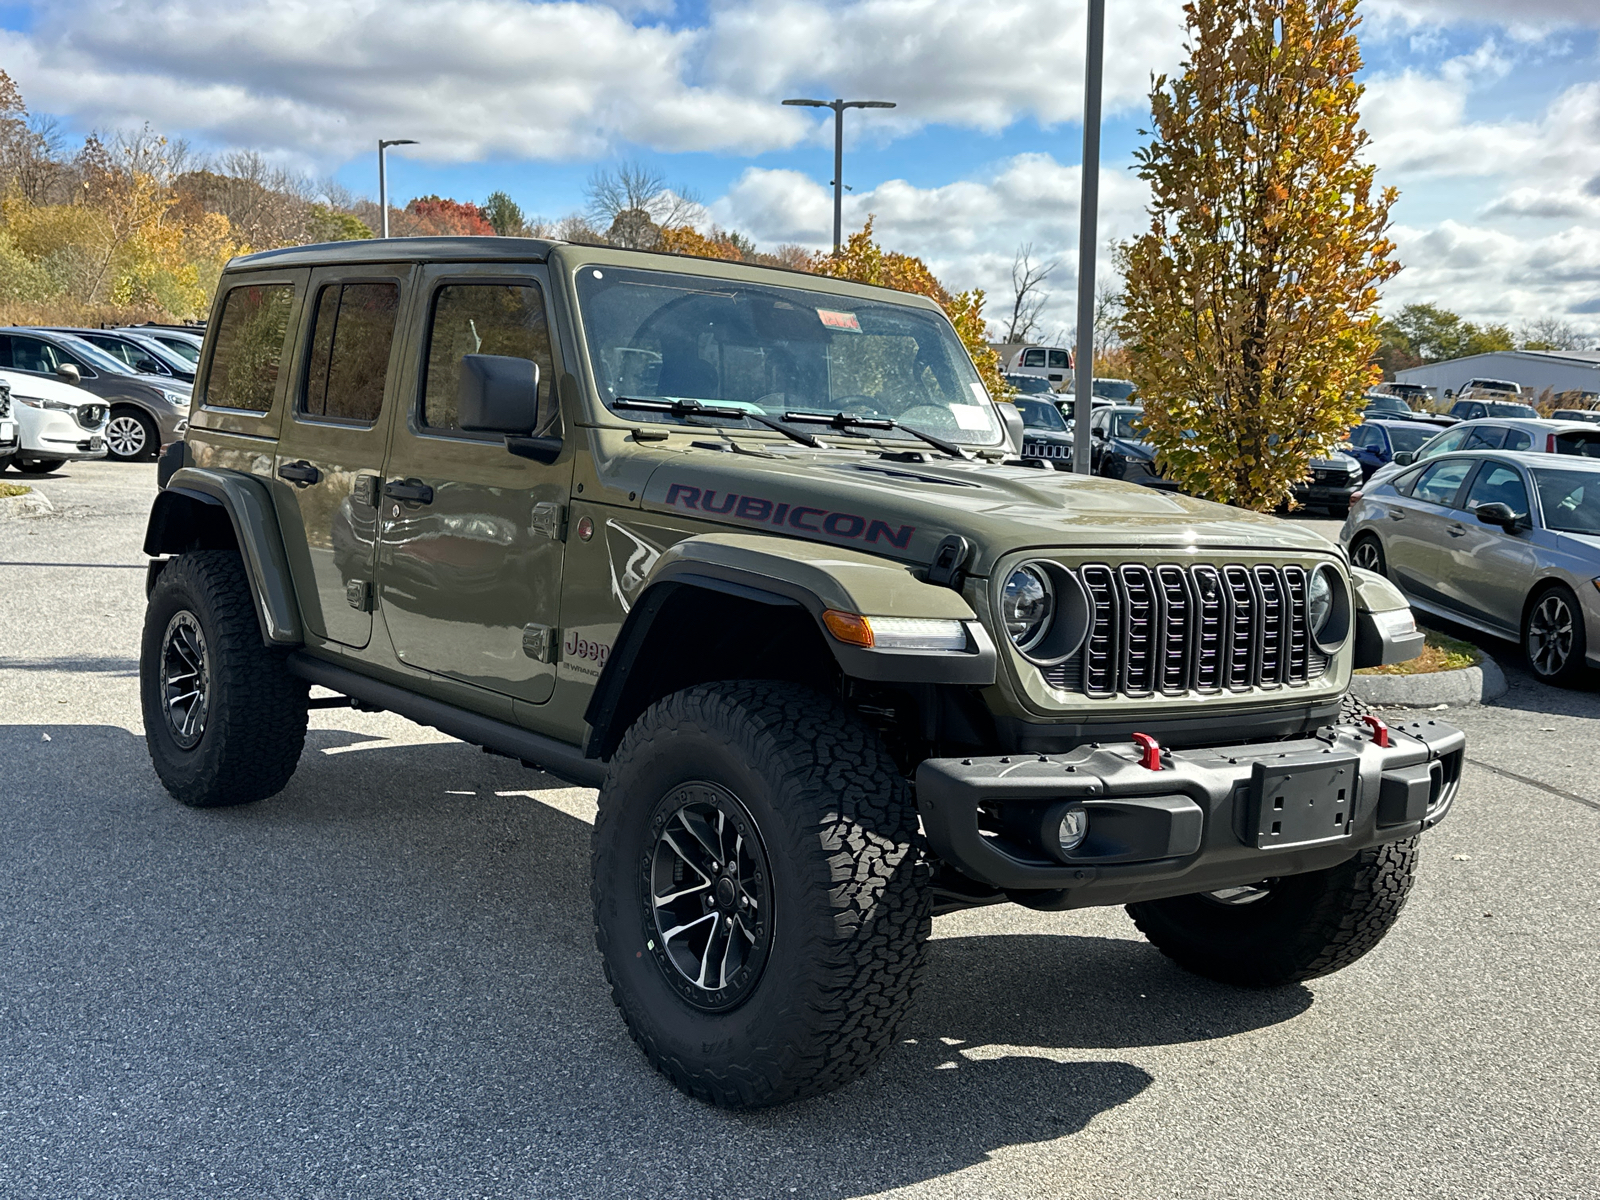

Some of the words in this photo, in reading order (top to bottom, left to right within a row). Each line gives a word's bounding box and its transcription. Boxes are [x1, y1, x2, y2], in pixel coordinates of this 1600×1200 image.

[665, 483, 916, 550] RUBICON
[565, 632, 610, 667] Jeep
[570, 663, 600, 678] WRANGL
